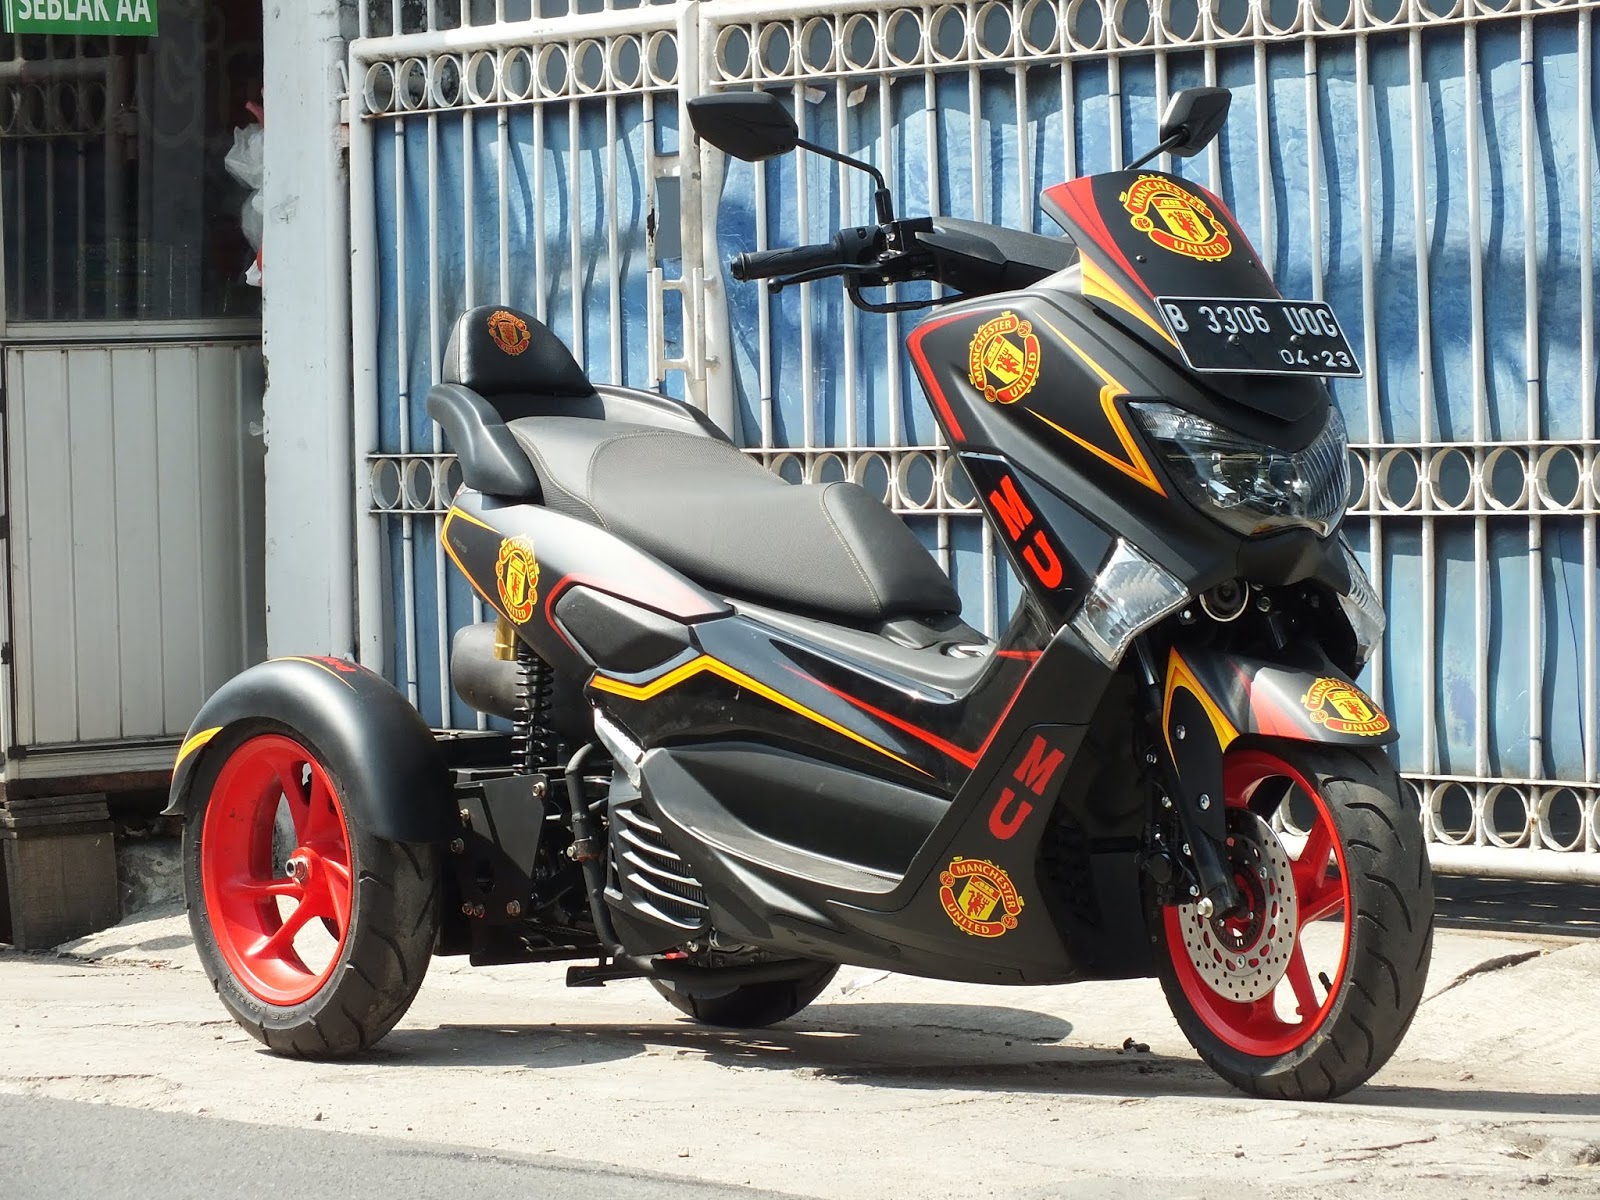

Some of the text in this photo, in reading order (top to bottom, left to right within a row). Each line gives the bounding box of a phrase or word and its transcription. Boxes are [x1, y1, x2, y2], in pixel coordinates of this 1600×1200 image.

[18, 0, 151, 23] SEBLAK AA
[1131, 180, 1208, 215] MANCHESTER
[1172, 239, 1226, 255] UNITED
[1164, 303, 1190, 333] B
[1198, 305, 1271, 335] 3306
[972, 319, 1013, 383] MANCHESTER
[1009, 351, 1038, 398] UNITED
[988, 474, 1063, 590] MU
[1342, 720, 1385, 732] UNITED
[988, 734, 1066, 841] MU
[956, 863, 1017, 909] MANCHESTER
[947, 902, 991, 935] UNITED
